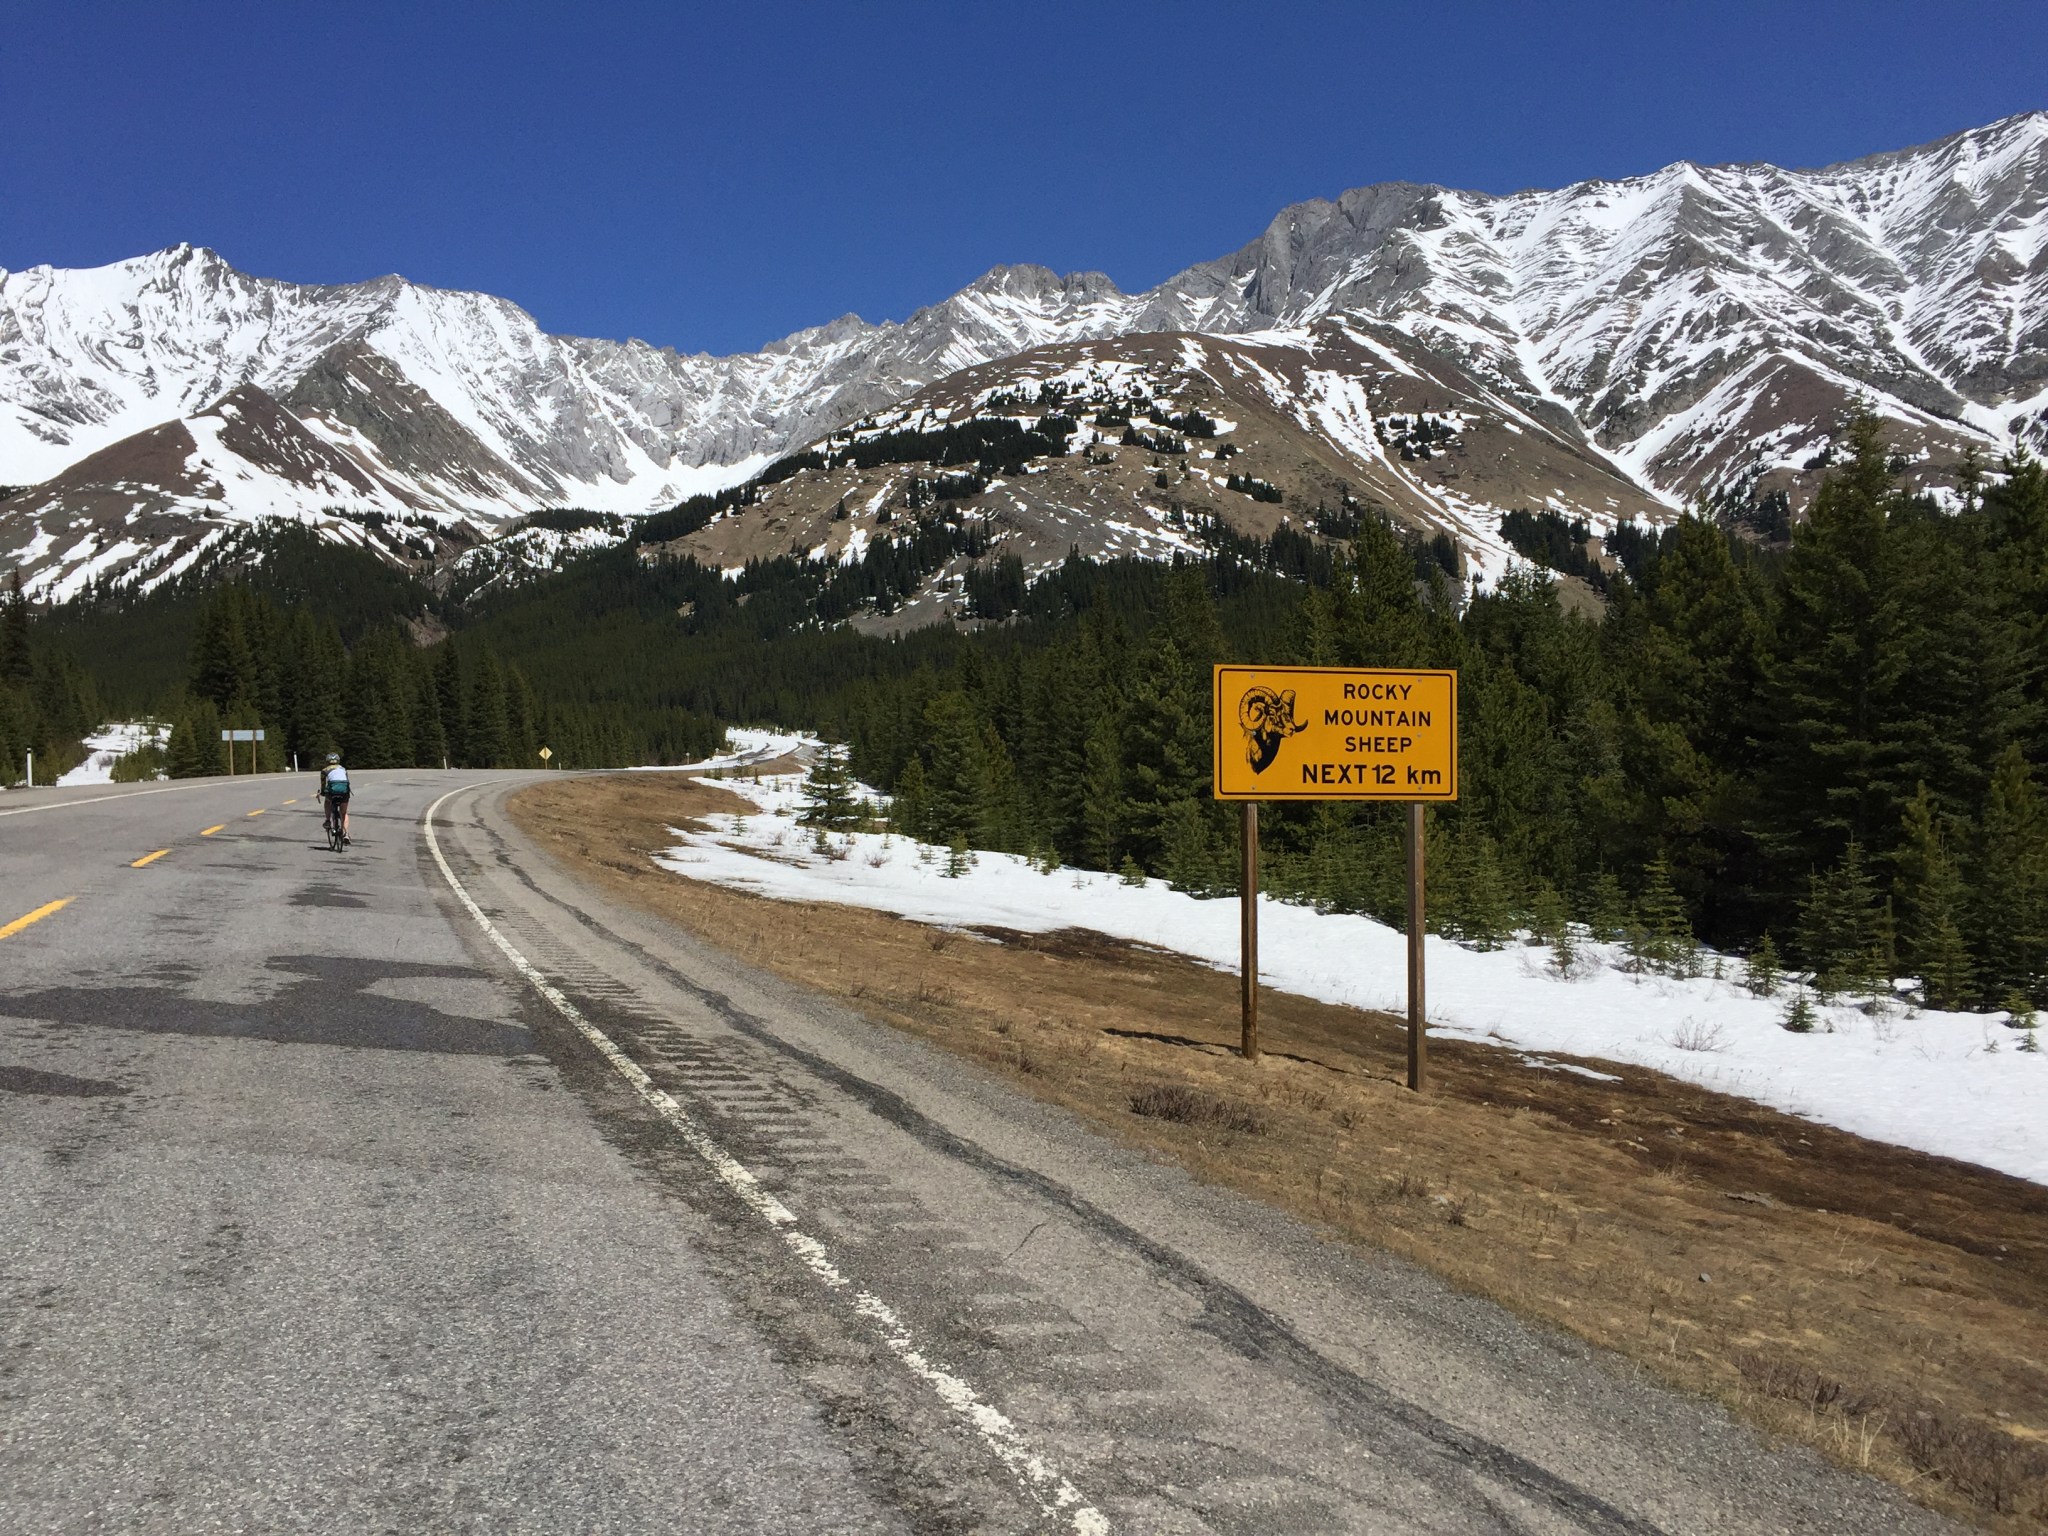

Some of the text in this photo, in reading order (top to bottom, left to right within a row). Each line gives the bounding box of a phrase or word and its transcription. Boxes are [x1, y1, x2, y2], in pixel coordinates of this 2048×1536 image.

[1343, 683, 1412, 701] ROCKY
[1324, 709, 1432, 727] MOUNTAIN
[1345, 736, 1412, 753] SHEEP
[1302, 764, 1441, 785] NEXT 12 km
